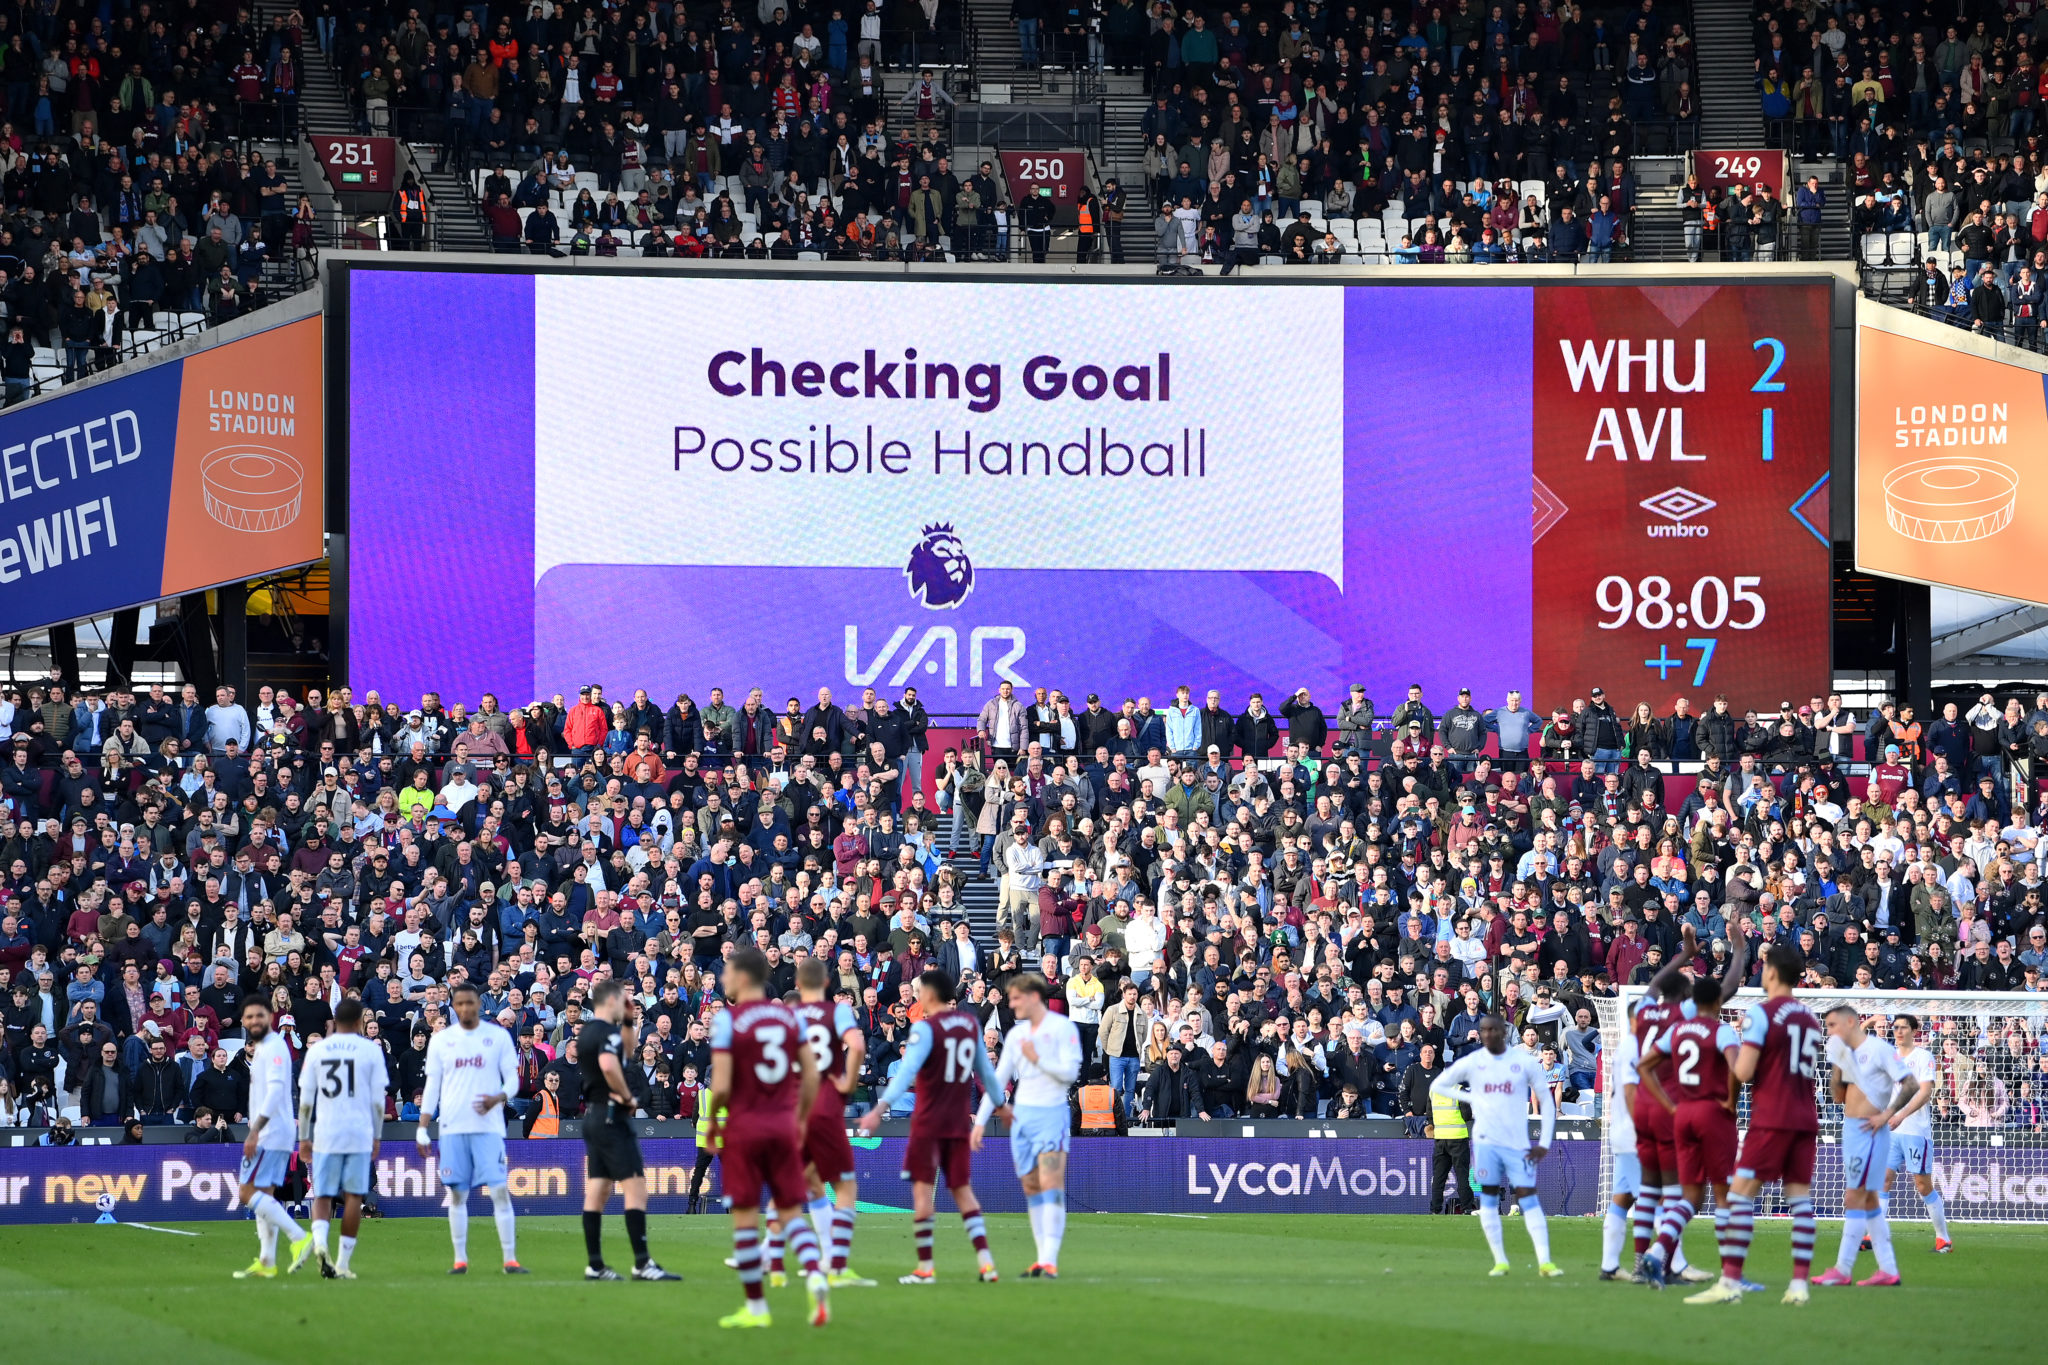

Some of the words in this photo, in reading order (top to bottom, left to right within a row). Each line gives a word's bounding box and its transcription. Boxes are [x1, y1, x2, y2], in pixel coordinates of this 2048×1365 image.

[329, 142, 374, 165] 251
[1019, 158, 1064, 180] 250
[1714, 156, 1761, 178] 249
[707, 347, 1001, 414] Checking
[1022, 352, 1171, 402] Goal
[1559, 338, 1706, 393] WHU
[1750, 337, 1786, 392] 2
[209, 389, 295, 415] LONDON
[209, 412, 295, 437] STADIUM
[1895, 402, 2008, 426] LONDON
[0, 409, 142, 504] ECTED
[674, 424, 912, 475] Possible
[934, 427, 1206, 477] Handball
[1585, 407, 1707, 461] AVL
[1762, 407, 1774, 461] 1
[1895, 425, 2008, 448] STADIUM
[1646, 522, 1709, 538] umbro
[1595, 575, 1767, 630] 98:05
[844, 624, 1032, 688] VAR
[1644, 638, 1718, 687] +7
[1881, 773, 1905, 782] betway
[753, 1024, 789, 1085] 3
[944, 1037, 977, 1084] 19
[1678, 1038, 1701, 1086] 2
[1786, 1023, 1823, 1079] 15
[320, 1058, 355, 1099] 31
[1908, 1147, 1922, 1161] 14
[44, 1173, 148, 1205] new
[161, 1160, 249, 1212] Pay
